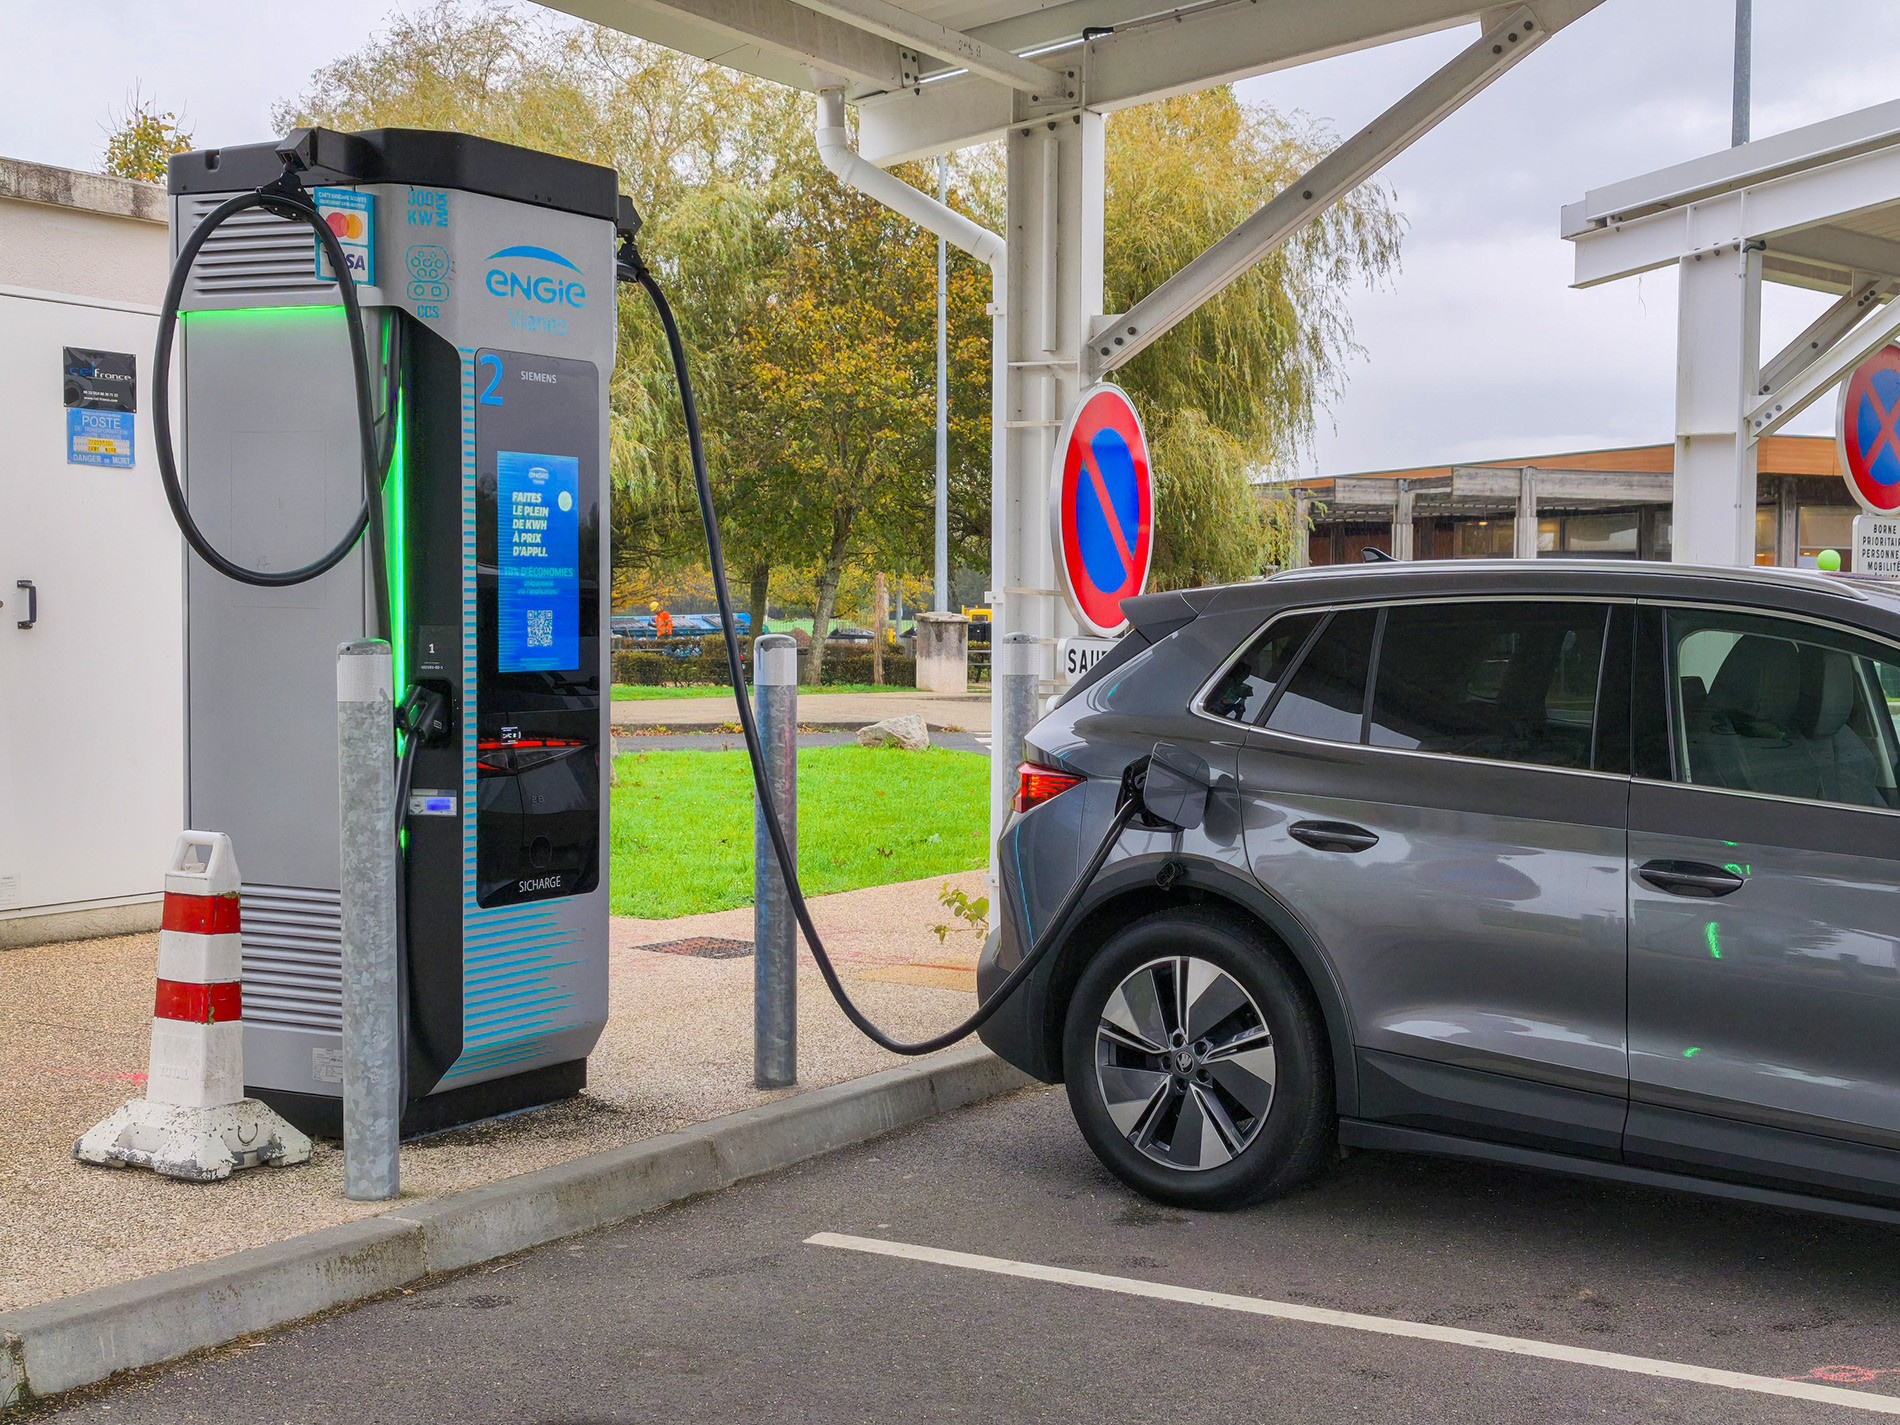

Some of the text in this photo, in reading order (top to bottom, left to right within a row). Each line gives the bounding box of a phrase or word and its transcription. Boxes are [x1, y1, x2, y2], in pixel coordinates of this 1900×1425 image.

[407, 190, 434, 207] 300
[436, 192, 448, 227] MAX
[407, 209, 432, 226] KW
[480, 354, 503, 406] 2
[520, 370, 557, 384] SIEMENS
[82, 415, 120, 428] POSTE
[73, 453, 102, 463] DANGER
[112, 456, 130, 464] MORT
[512, 492, 542, 503] FAITES
[512, 505, 549, 518] LE PLEIN
[512, 519, 547, 530] DE KWH
[1873, 524, 1896, 534] BORNE
[512, 530, 541, 543] À PRIX
[428, 643, 435, 653] 1
[1067, 648, 1109, 674] SAU
[518, 875, 561, 893] SICHARGE
